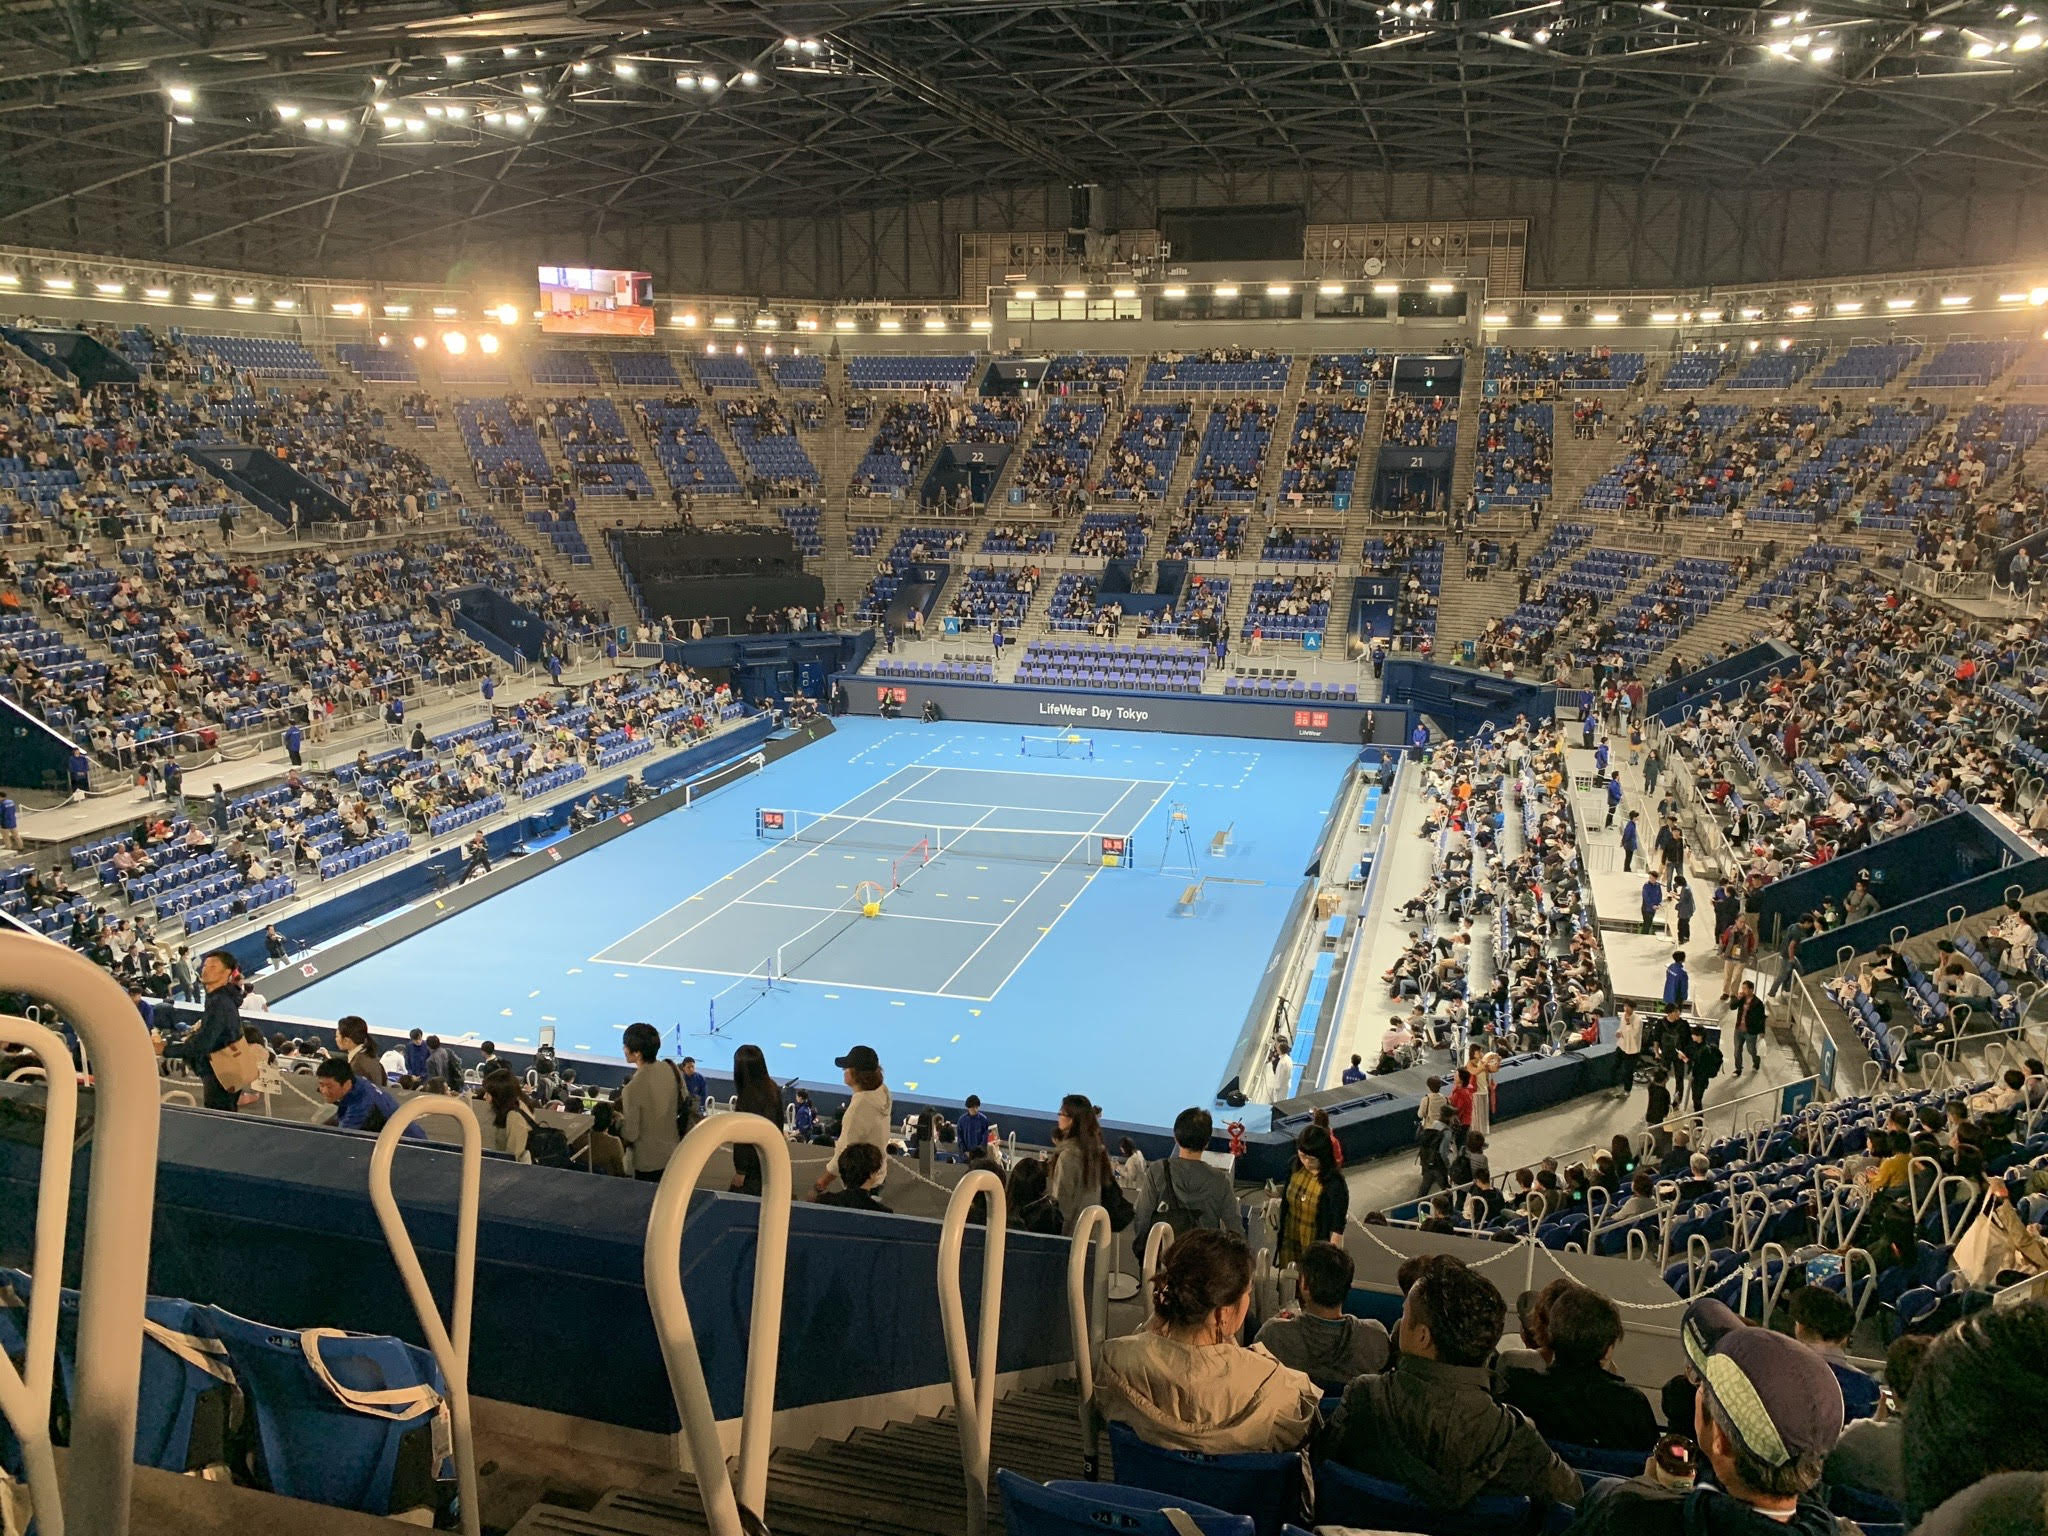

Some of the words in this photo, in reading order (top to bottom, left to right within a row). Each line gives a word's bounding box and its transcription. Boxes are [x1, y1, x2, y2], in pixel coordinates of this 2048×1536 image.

[42, 343, 56, 356] 33
[1015, 368, 1027, 379] 32
[1424, 366, 1435, 377] 31
[1359, 384, 1368, 392] Q
[1487, 383, 1494, 393] X
[971, 452, 984, 463] 22
[1410, 457, 1423, 467] 21
[220, 458, 233, 470] 23
[1479, 499, 1486, 508] P
[924, 570, 935, 580] 12
[1371, 585, 1383, 596] 11
[451, 599, 461, 609] 13
[948, 621, 956, 630] A
[1306, 636, 1316, 647] A
[1464, 644, 1471, 655] H
[1040, 702, 1088, 717] LifeWear
[1091, 705, 1112, 721] Day
[1116, 707, 1149, 722] Tokyo
[1824, 1051, 1831, 1075] G
